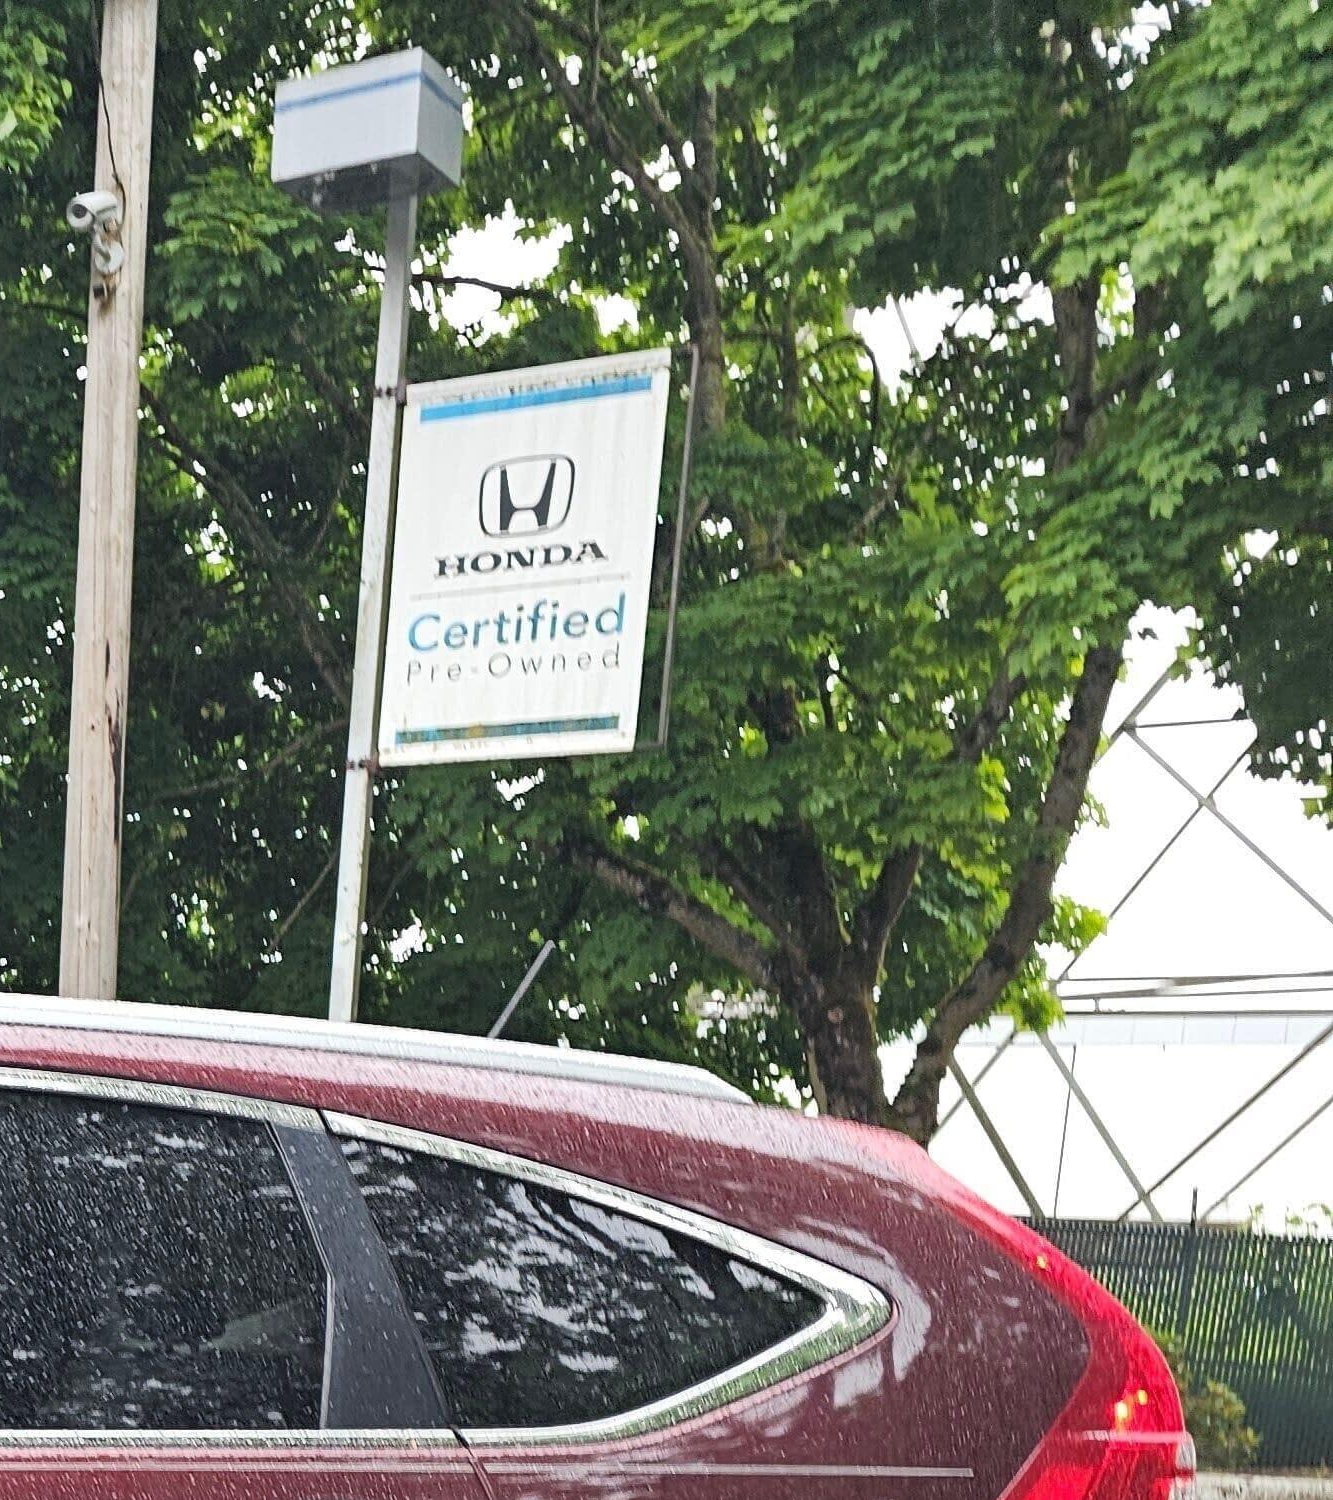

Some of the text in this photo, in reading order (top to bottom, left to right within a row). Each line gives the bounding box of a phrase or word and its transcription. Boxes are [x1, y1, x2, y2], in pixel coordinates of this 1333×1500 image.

[436, 541, 607, 578] HONDA
[409, 592, 626, 652] Certified
[406, 641, 621, 686] Pre-Owned
